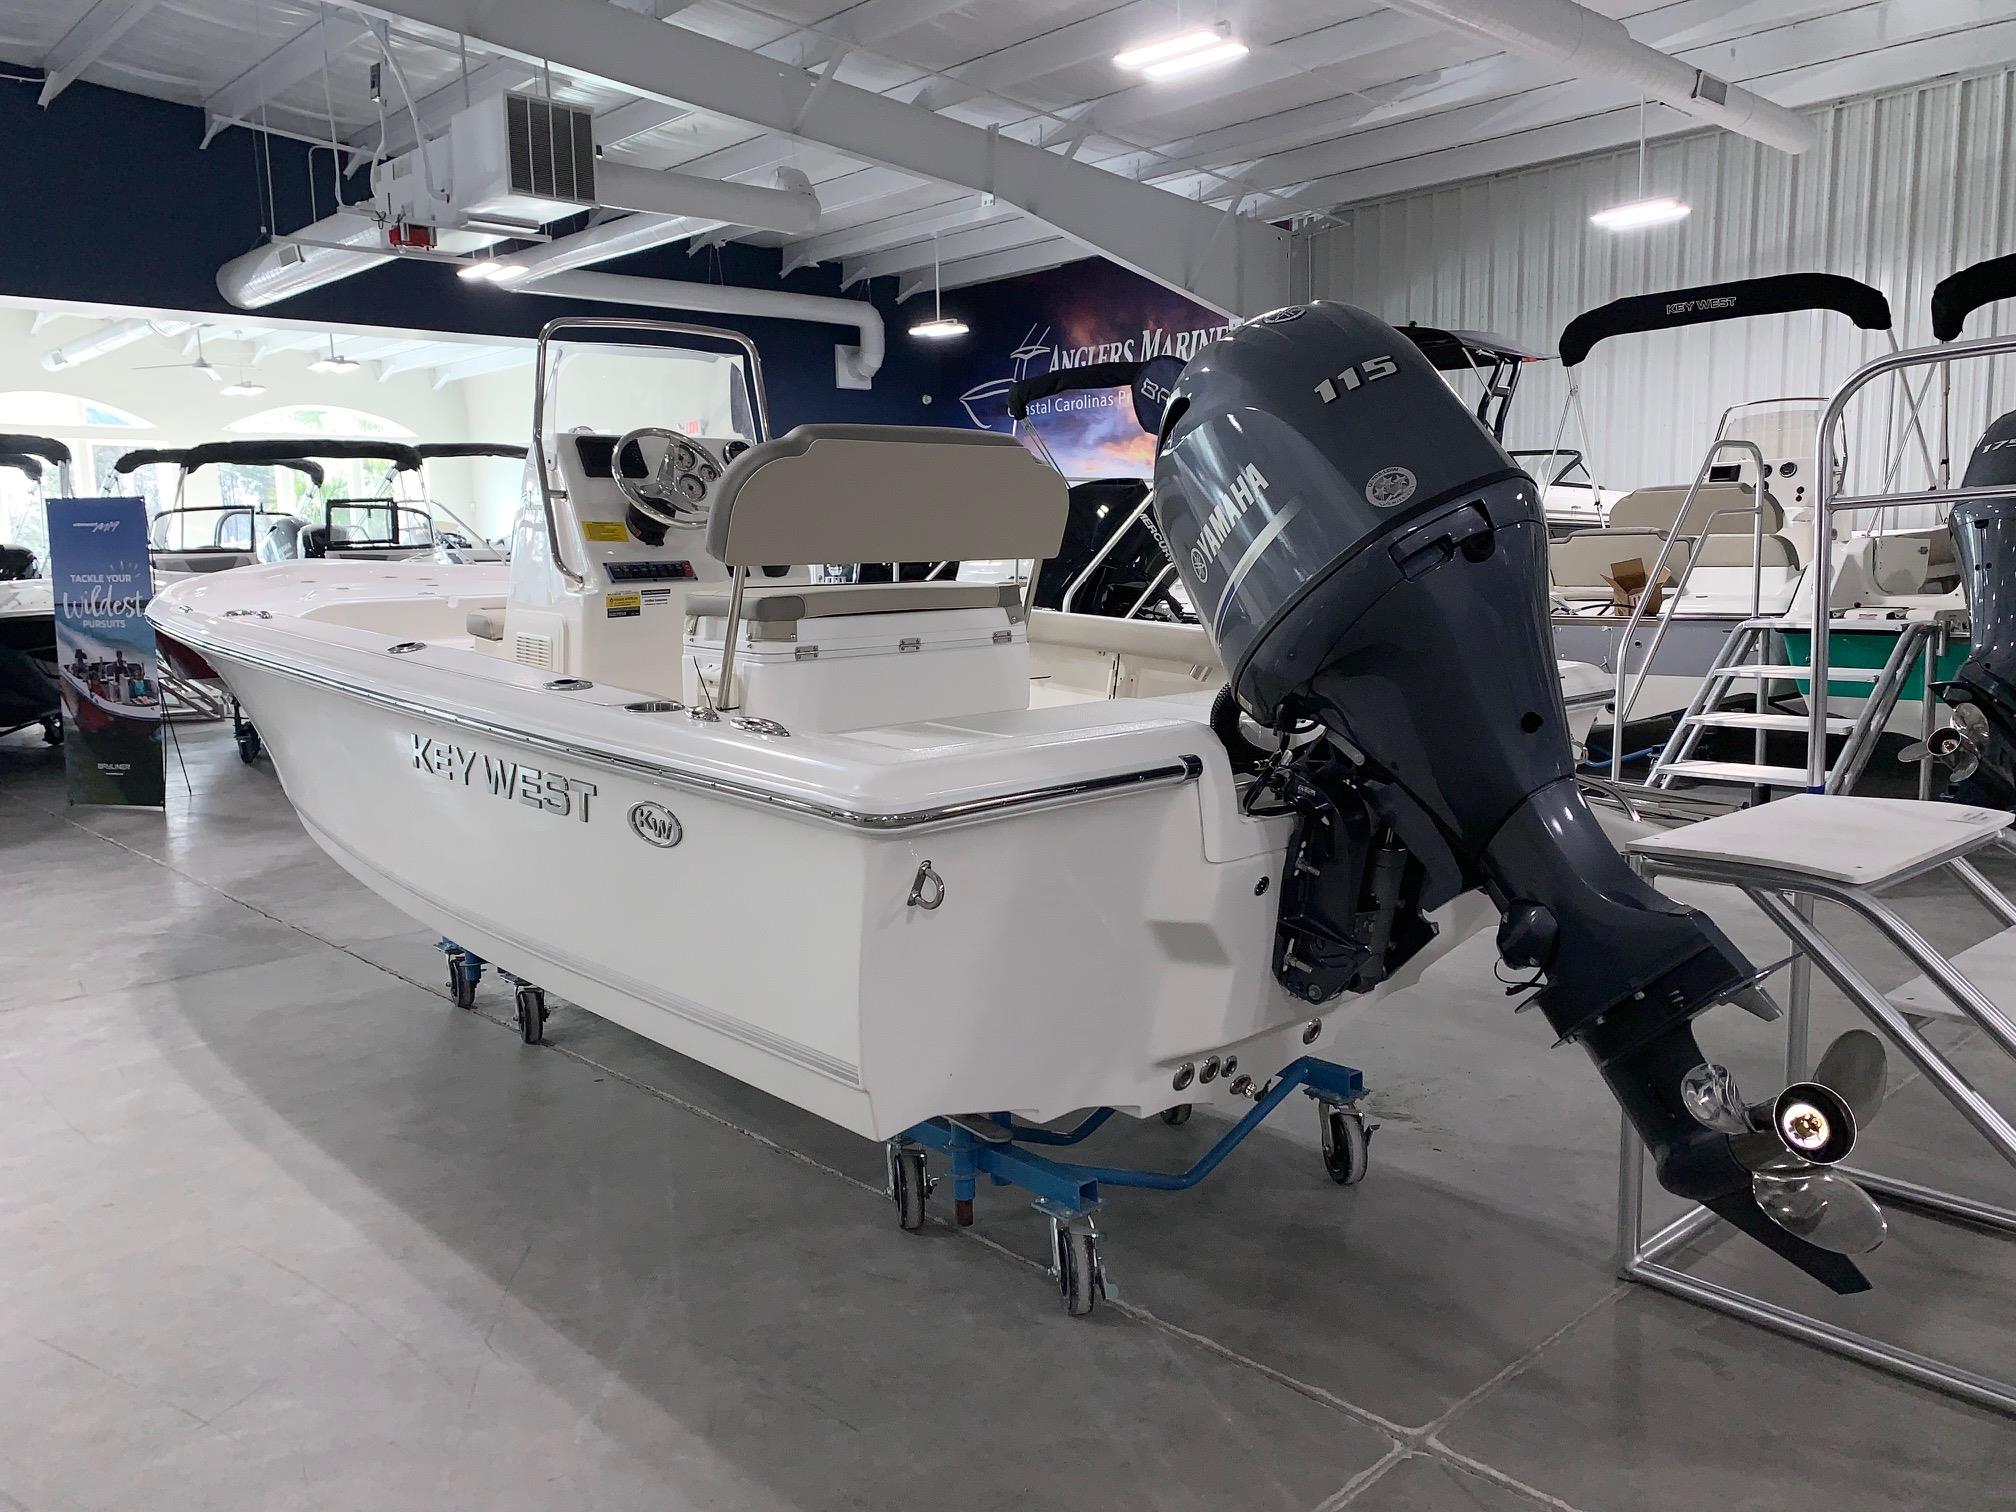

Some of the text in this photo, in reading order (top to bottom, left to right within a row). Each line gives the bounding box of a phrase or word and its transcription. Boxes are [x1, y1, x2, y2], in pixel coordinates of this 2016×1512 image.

[1665, 296, 1737, 315] KEY WEST
[1313, 354, 1398, 404] 115
[1007, 390, 1132, 418] astal Carolinas Pr
[1196, 462, 1270, 565] YAMAHA
[69, 574, 132, 583] TACKLE YOUR
[62, 584, 144, 619] Wildest
[82, 619, 126, 629] PURSUITS
[409, 732, 598, 823] KEY WEST
[637, 807, 674, 841] KW
